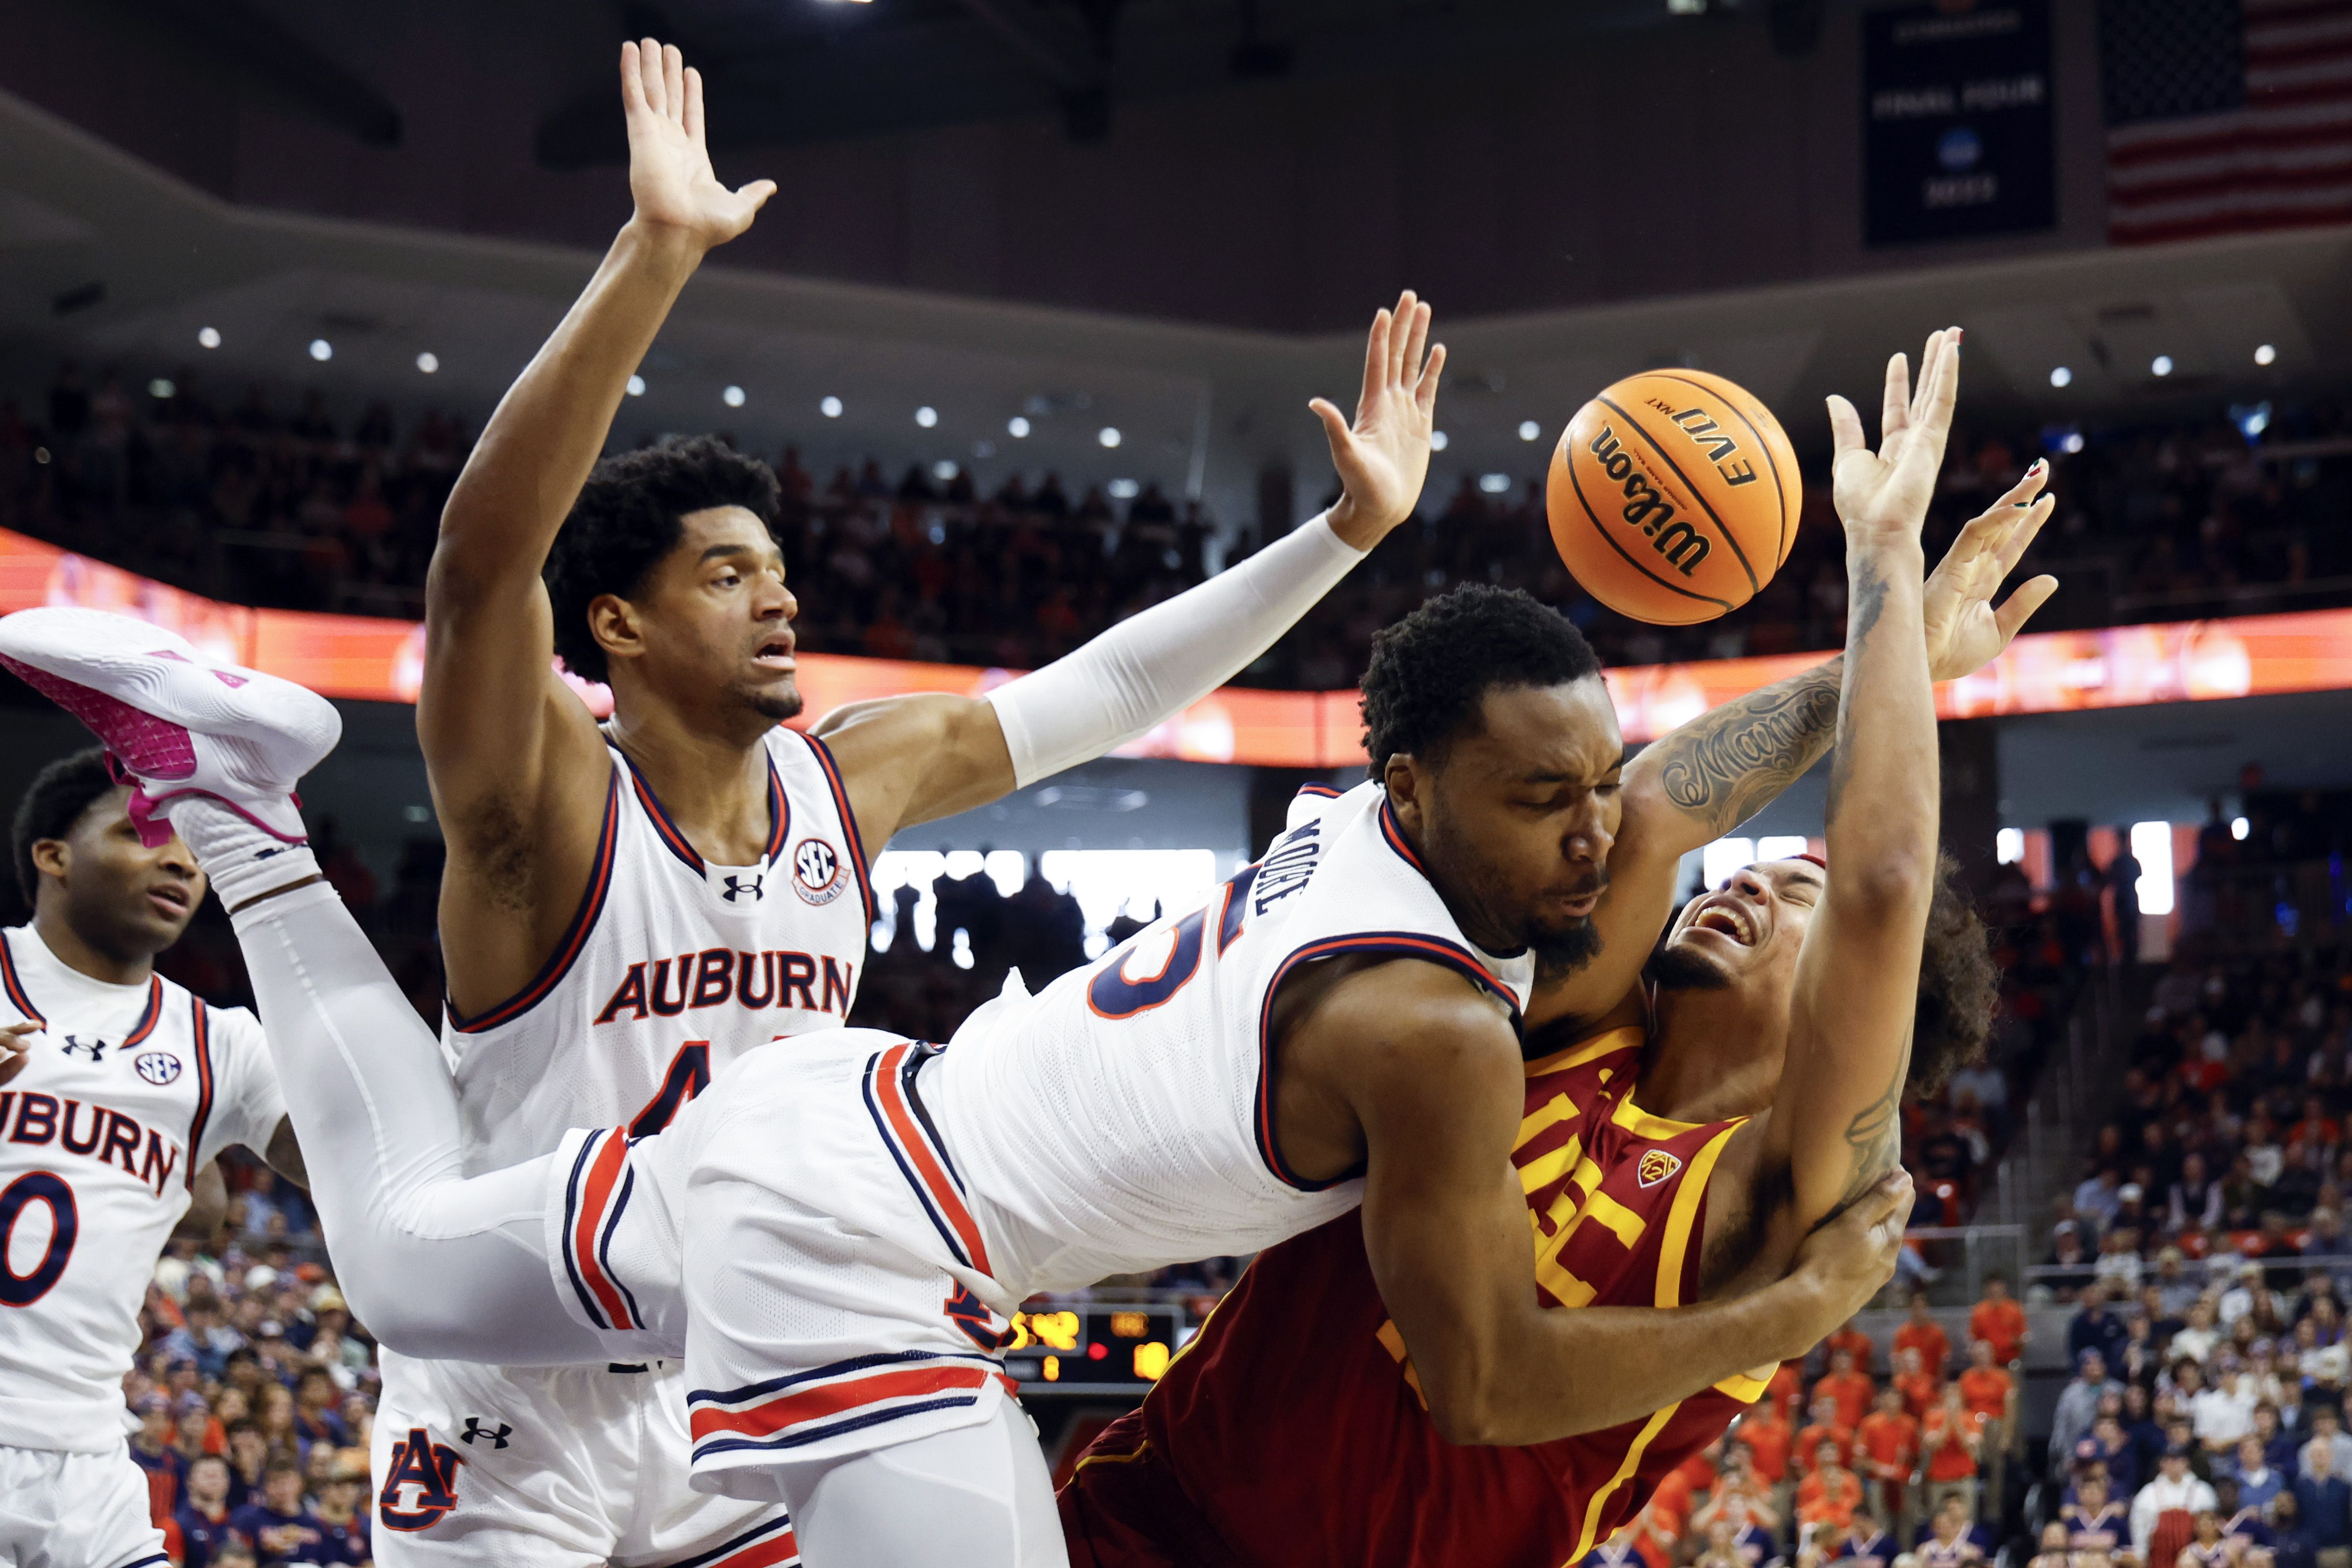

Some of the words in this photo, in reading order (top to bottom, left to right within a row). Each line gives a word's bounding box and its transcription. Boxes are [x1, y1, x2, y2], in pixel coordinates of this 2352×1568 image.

[1644, 398, 1675, 415] NXT
[1670, 408, 1757, 487] EVO
[1590, 425, 1711, 577] Wilson
[1663, 685, 1840, 807] Mama
[797, 841, 835, 888] SEC
[800, 881, 844, 903] GRADUATE
[593, 948, 852, 1026] AUBURN
[137, 1054, 180, 1083] SEC
[0, 1091, 177, 1199] BURN
[1642, 1164, 1663, 1181] 12
[0, 1170, 78, 1308] 0
